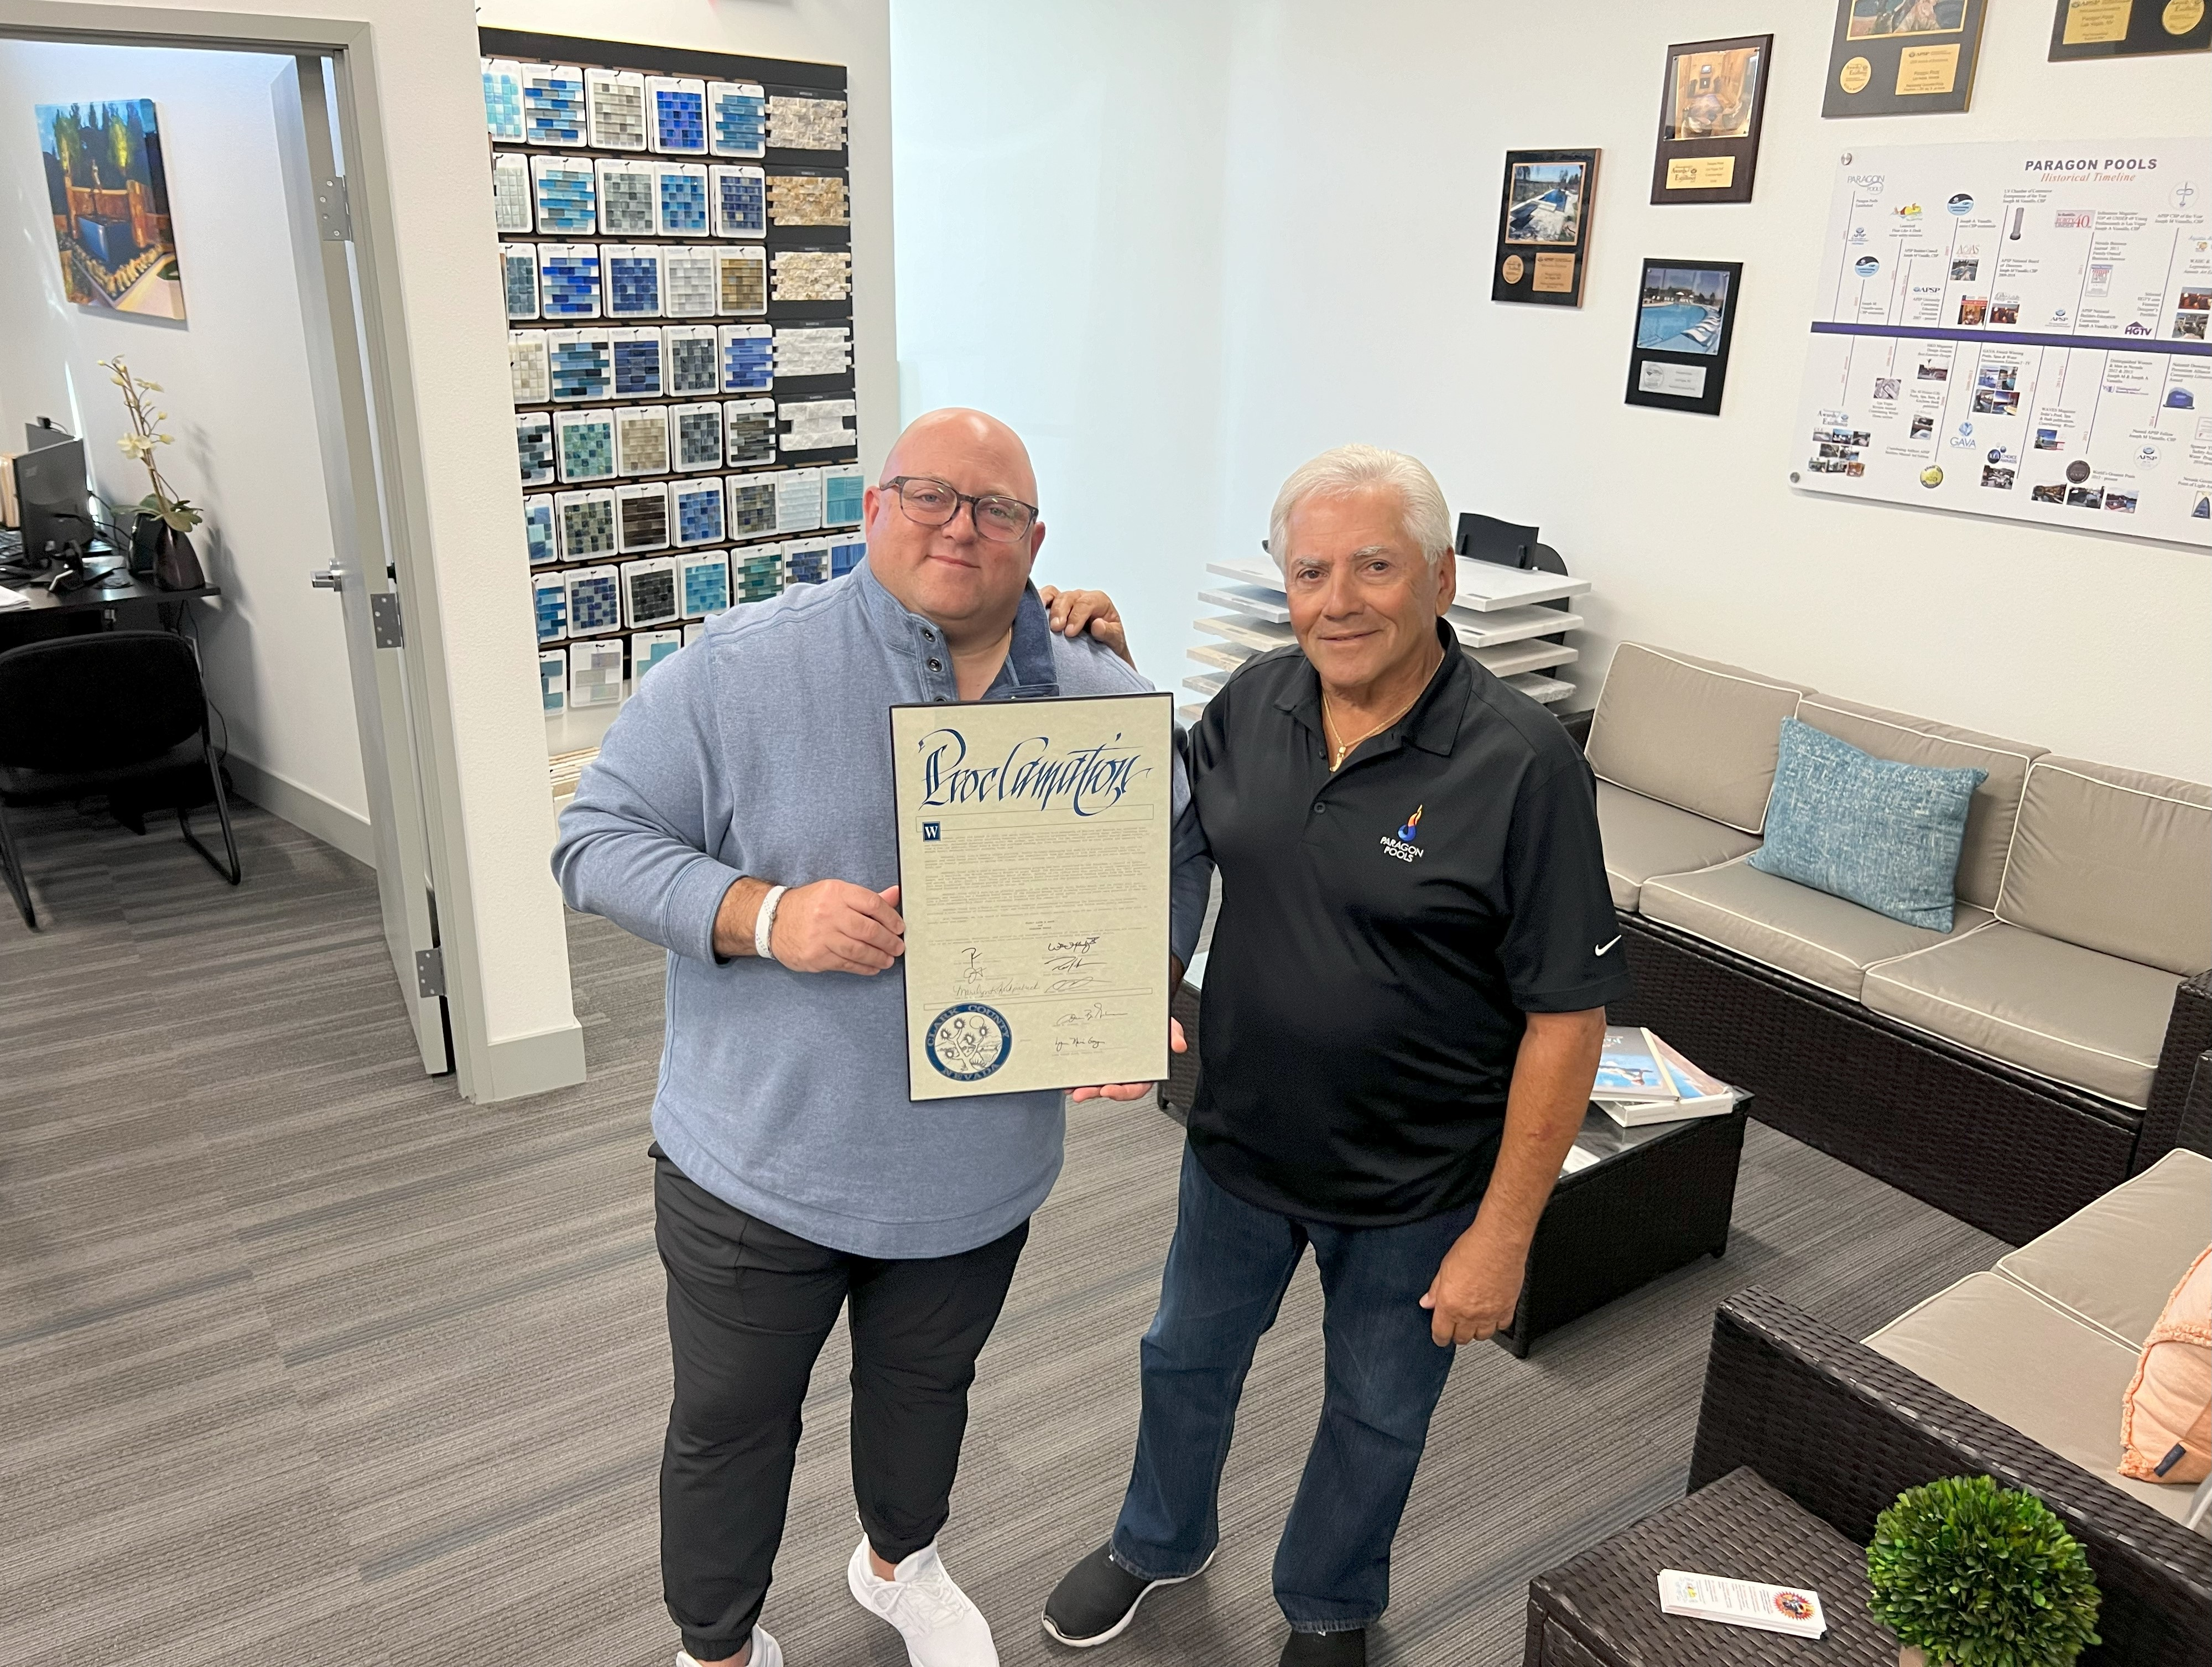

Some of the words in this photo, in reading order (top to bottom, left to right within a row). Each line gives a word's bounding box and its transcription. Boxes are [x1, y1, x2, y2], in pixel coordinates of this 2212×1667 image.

[2024, 159, 2098, 171] PARAGON
[2104, 159, 2158, 170] POOLS
[1847, 175, 1885, 183] PARAGON
[2041, 173, 2091, 182] Historical
[2093, 173, 2136, 181] Timeline
[2074, 214, 2090, 227] 40
[2125, 327, 2152, 336] HGTV
[1950, 437, 1976, 448] GAVA
[918, 728, 1154, 817] Proclamation
[924, 825, 938, 839] W
[1380, 836, 1423, 858] PARAGON
[1384, 846, 1414, 863] POOLS
[927, 1008, 959, 1046] CLARK
[968, 1005, 1009, 1037] COUNTY
[941, 1063, 1001, 1081] NEVADA
